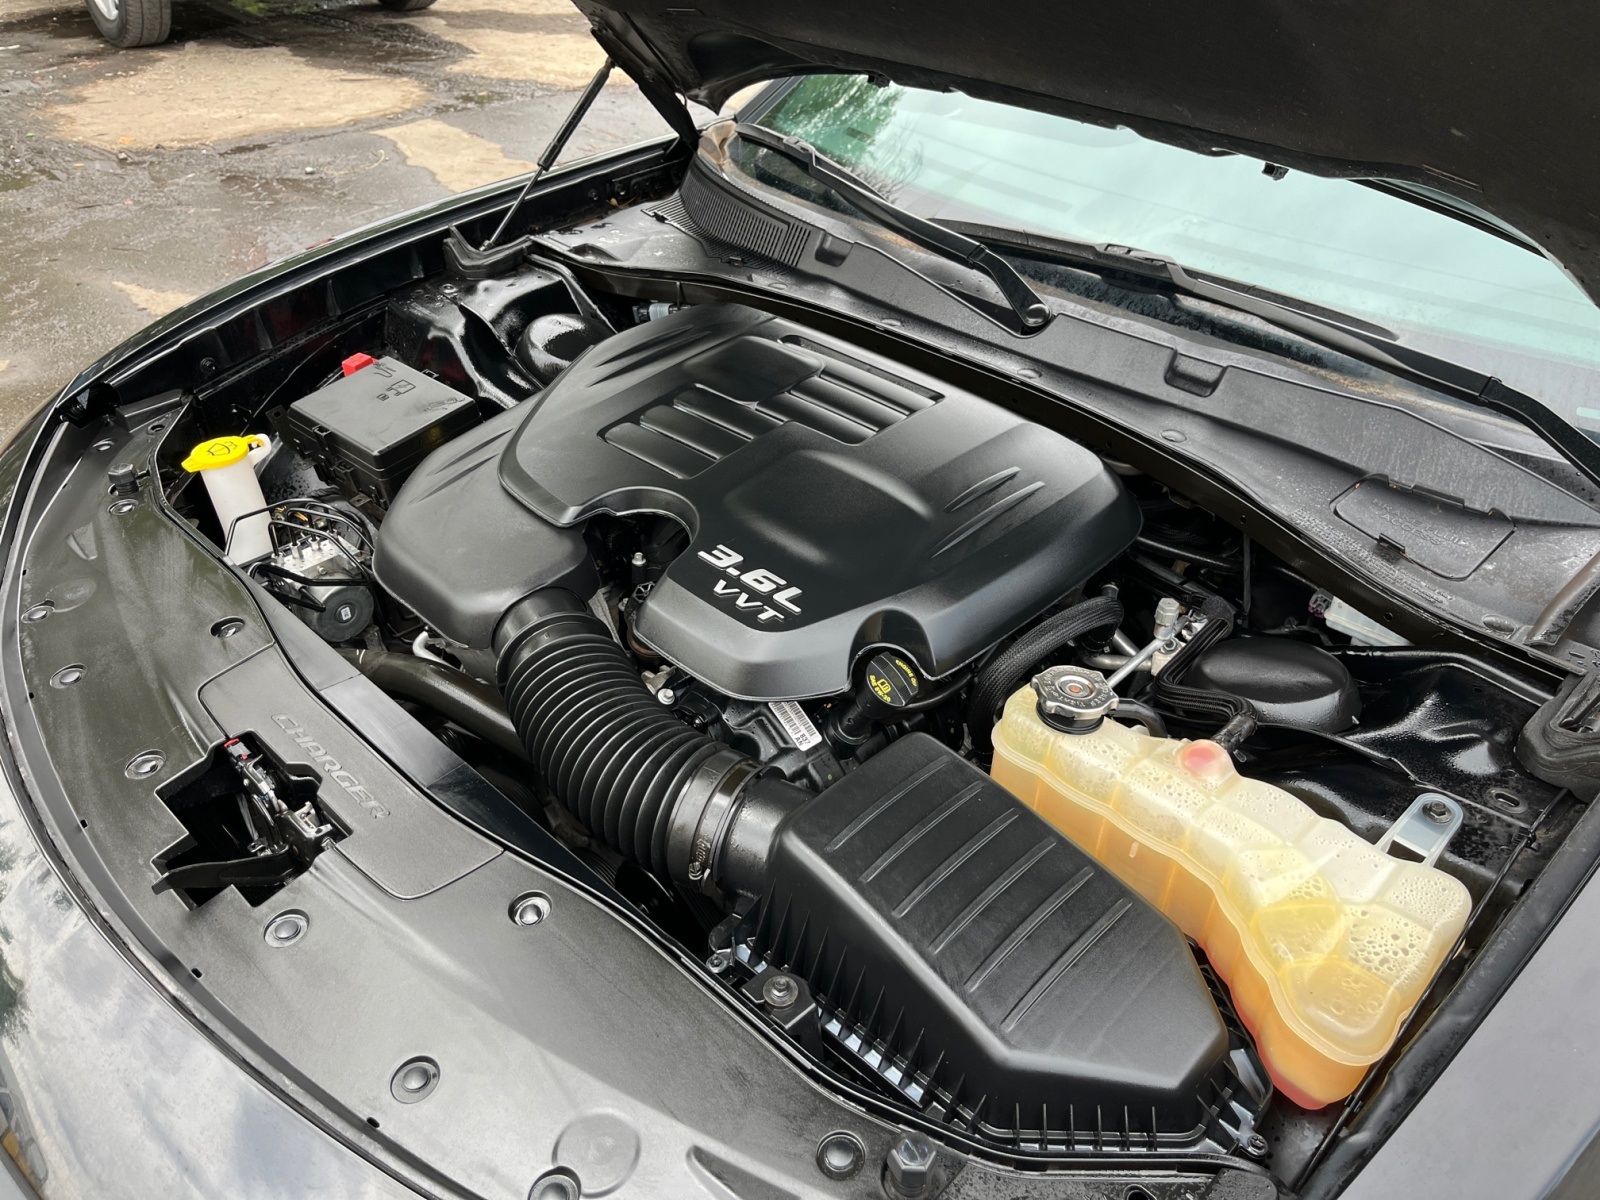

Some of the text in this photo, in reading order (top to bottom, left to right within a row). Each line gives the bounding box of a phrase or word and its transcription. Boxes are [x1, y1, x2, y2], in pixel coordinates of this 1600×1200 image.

[1372, 498, 1469, 546] BRAKE FLUID
[1380, 513, 1441, 546] ACCESS
[697, 544, 802, 614] 3.6L
[713, 579, 785, 621] VVT
[270, 713, 390, 819] CHARGER
